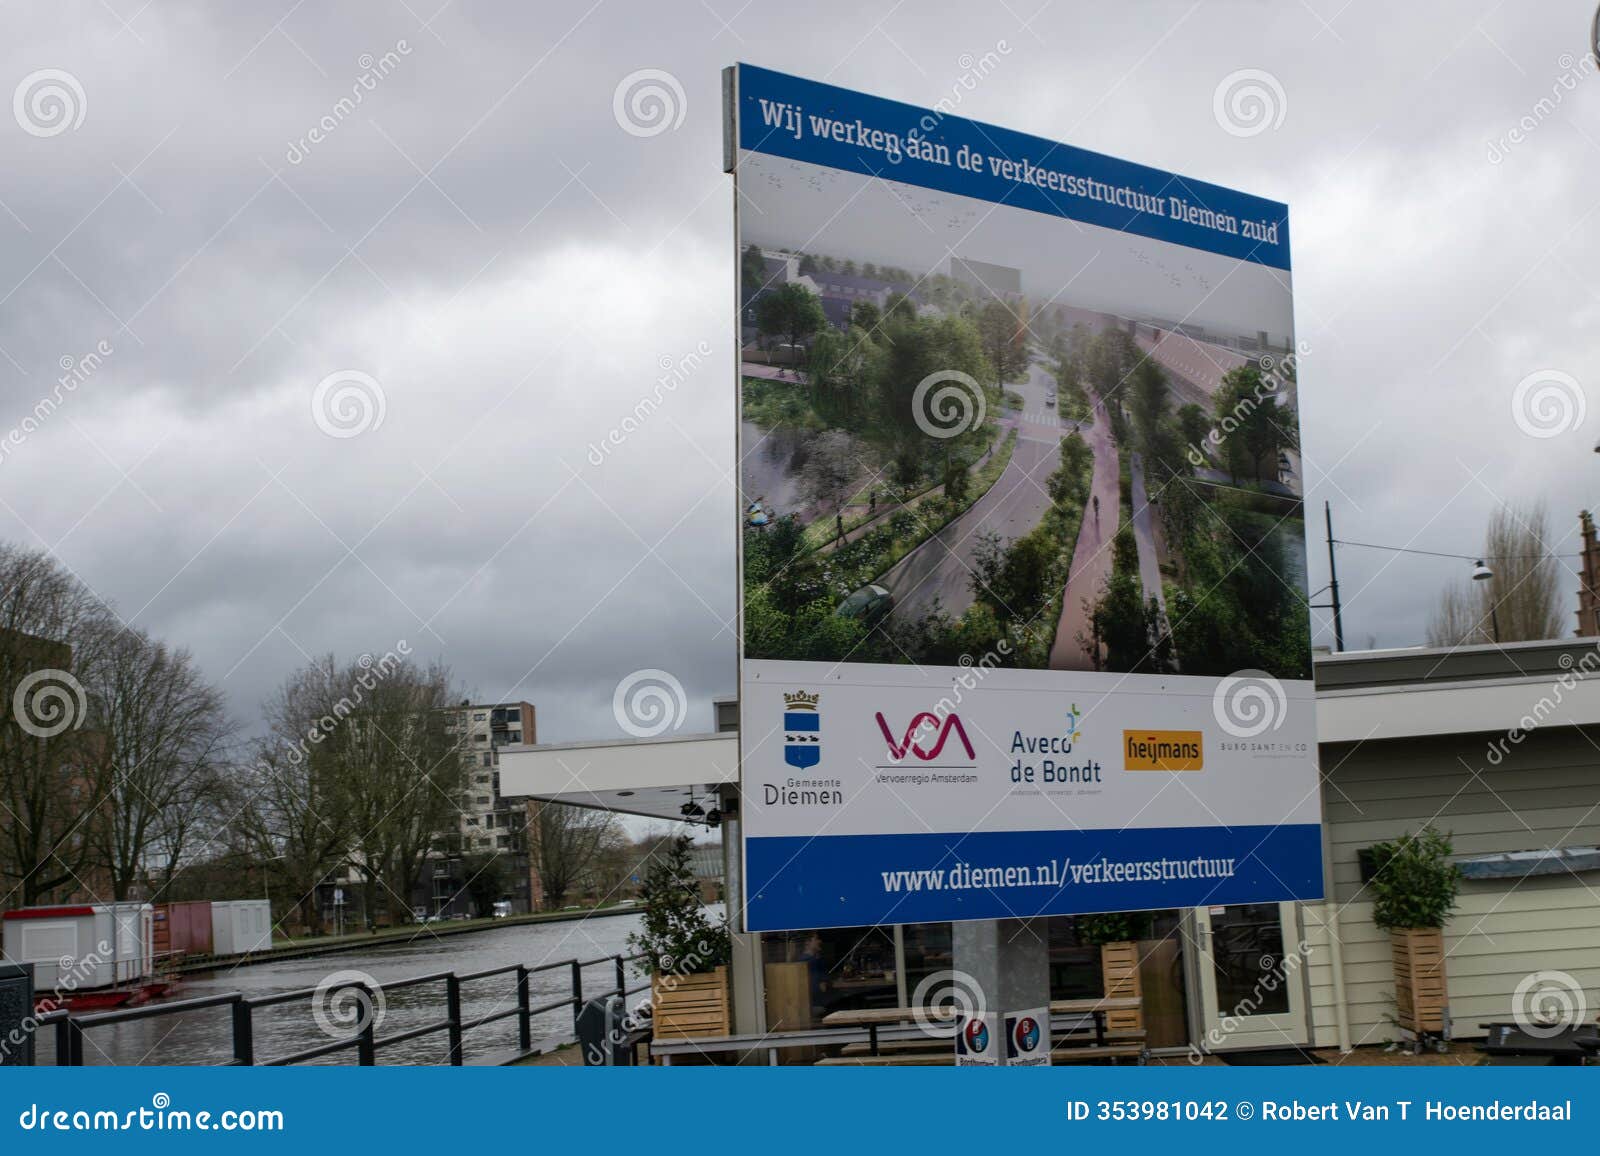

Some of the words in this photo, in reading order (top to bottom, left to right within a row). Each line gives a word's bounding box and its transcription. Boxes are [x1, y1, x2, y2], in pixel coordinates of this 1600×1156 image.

[759, 98, 802, 140] Wij
[809, 115, 901, 155] werken
[907, 136, 951, 166] aan
[956, 144, 983, 173] de
[988, 156, 1165, 217] verkeersstructuur
[1169, 197, 1238, 234] Diemen
[1241, 218, 1280, 245] zuid
[1010, 730, 1073, 754] Aveco
[1127, 736, 1200, 764] heijmans
[787, 778, 841, 788] Gemeente
[876, 773, 930, 785] Vervoerregio
[931, 773, 978, 784] Amsterdam
[1010, 760, 1034, 783] de
[1043, 761, 1102, 783] Bondt
[763, 783, 843, 806] Diemen
[881, 857, 1236, 893] www.diemen.nl/verkeersstructuur
